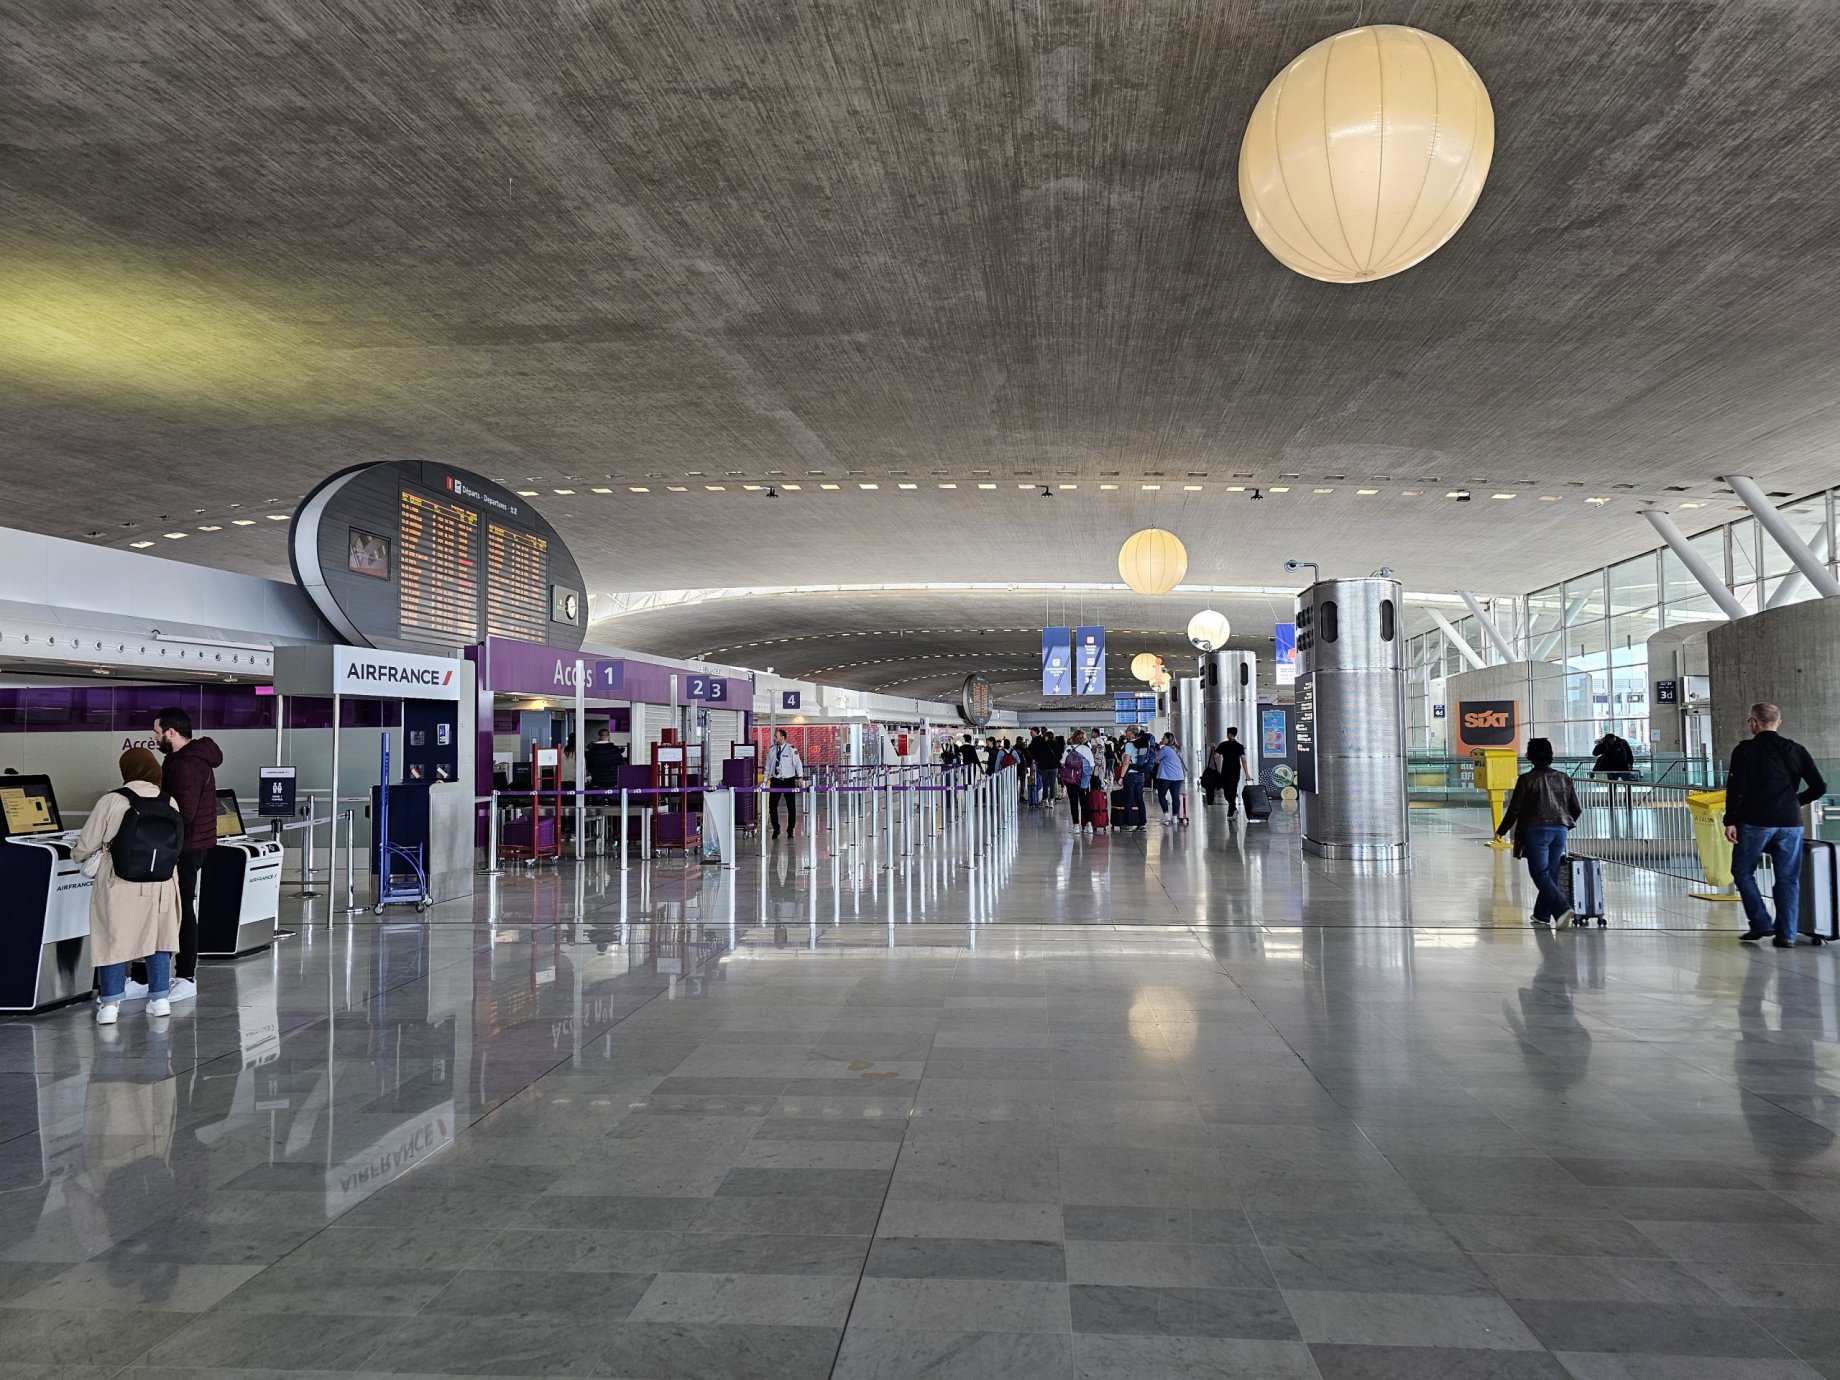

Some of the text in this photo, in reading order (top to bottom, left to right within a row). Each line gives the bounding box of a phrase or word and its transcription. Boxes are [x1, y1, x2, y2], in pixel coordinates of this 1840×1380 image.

[462, 485, 480, 499] Départs
[483, 494, 507, 511] Departures
[347, 662, 440, 686] AIRFRANCE
[603, 667, 613, 685] 1
[693, 680, 704, 695] 2
[711, 683, 721, 698] 3
[1660, 690, 1673, 699] 3d
[787, 694, 796, 706] 4
